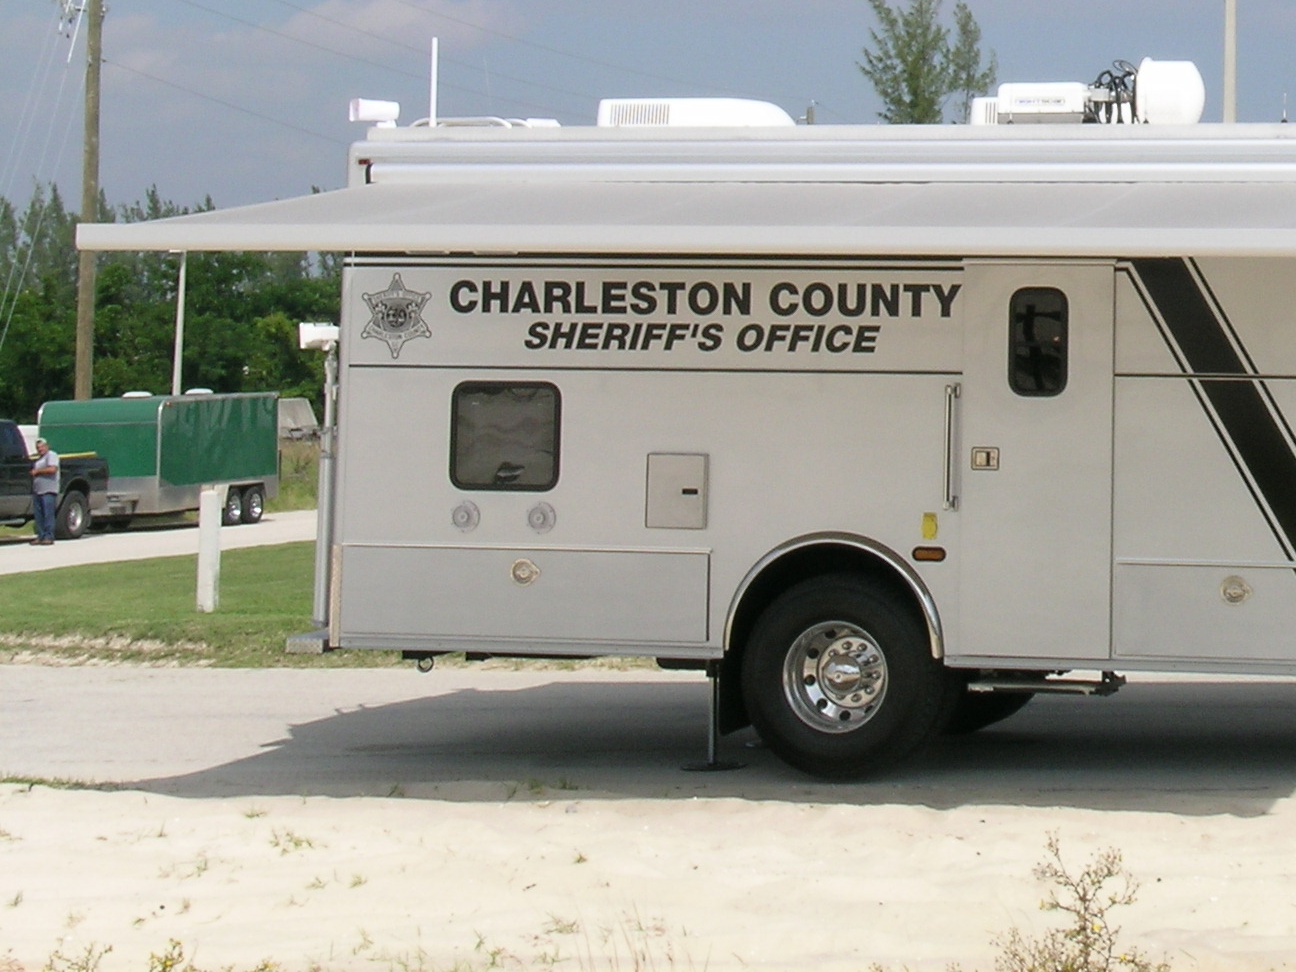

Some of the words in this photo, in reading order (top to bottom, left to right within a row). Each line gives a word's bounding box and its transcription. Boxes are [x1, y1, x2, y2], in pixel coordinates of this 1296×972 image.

[449, 279, 752, 316] CHARLESTON
[769, 281, 963, 318] COUNTY
[524, 321, 724, 352] SHERIFF'S
[736, 323, 881, 354] OFFICE
